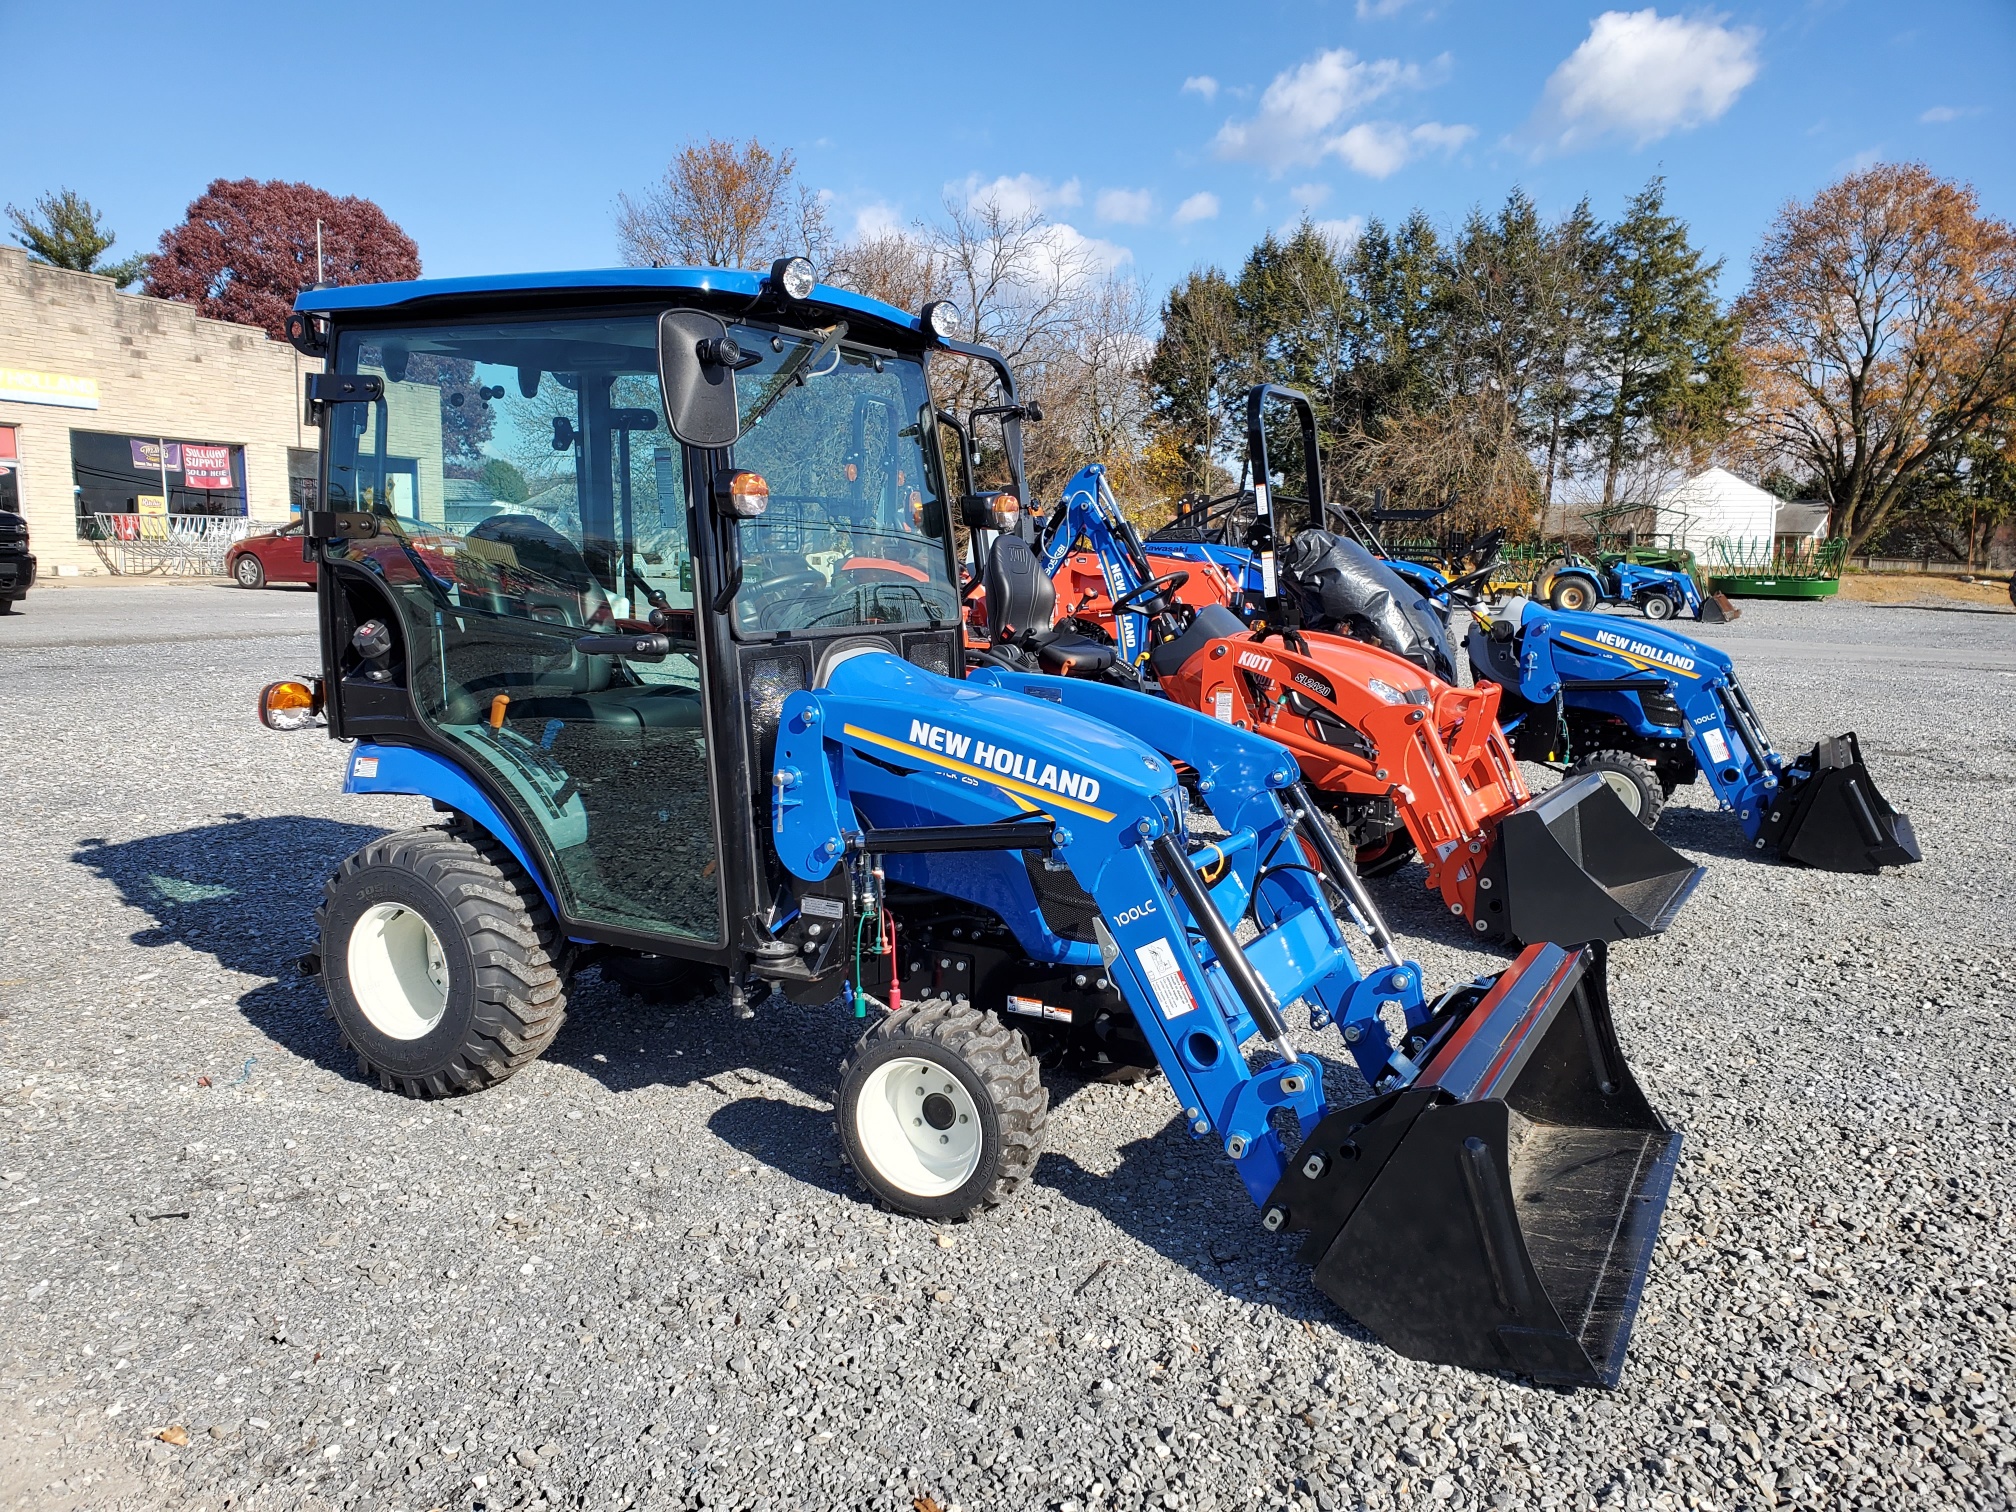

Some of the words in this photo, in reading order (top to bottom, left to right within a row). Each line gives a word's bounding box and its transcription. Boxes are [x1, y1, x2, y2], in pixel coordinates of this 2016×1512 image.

[1111, 563, 1127, 591] NEW
[1596, 630, 1630, 650] NEW
[1630, 642, 1695, 671] HOLLAND
[1237, 650, 1273, 673] KIOTI
[1294, 672, 1331, 697] SL2420
[1693, 712, 1717, 726] 100LC
[909, 719, 972, 759] NEW
[974, 741, 1101, 803] HOLLAND
[1113, 899, 1157, 927] 100LC
